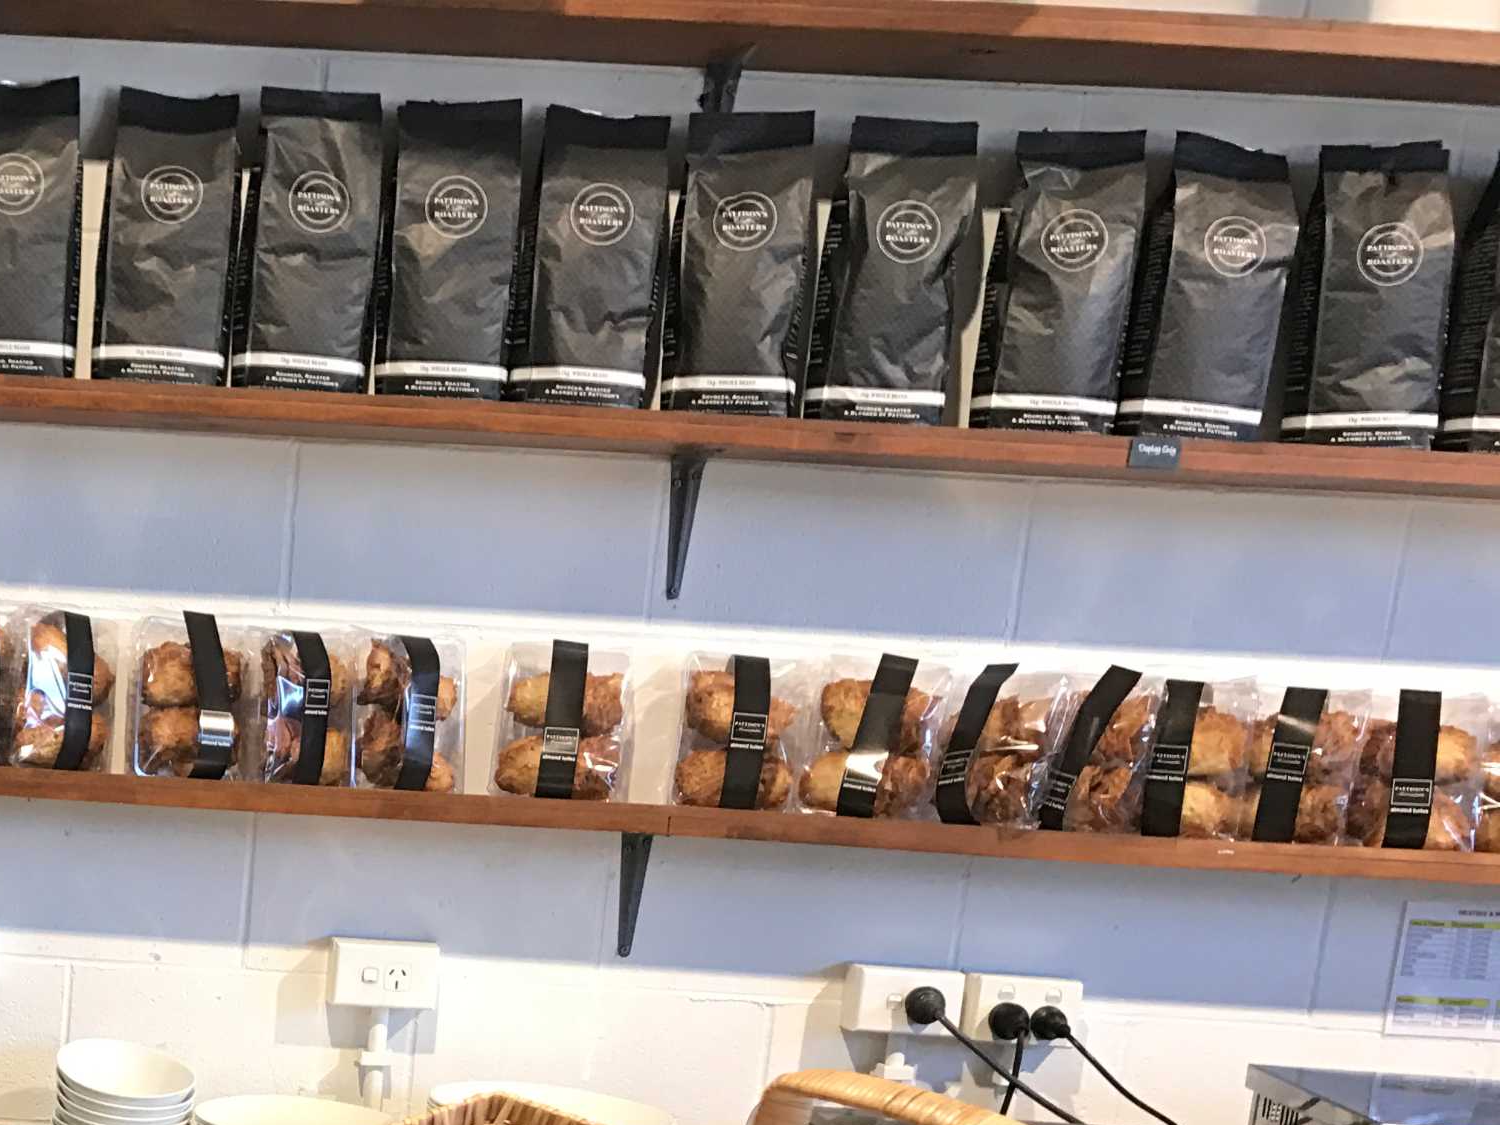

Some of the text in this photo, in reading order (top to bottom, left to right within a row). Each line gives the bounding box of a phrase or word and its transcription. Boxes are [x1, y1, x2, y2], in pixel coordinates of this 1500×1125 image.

[297, 191, 341, 202] PATTISON'S
[434, 197, 479, 206] PATTISON'S
[297, 205, 340, 215] ROASTERS
[579, 204, 625, 214] PATTISON'S
[722, 209, 768, 219] PATTISON'S
[434, 211, 478, 219] ROASTERS
[722, 223, 767, 232] ROASTERS
[886, 220, 932, 230] PATTISON'S
[885, 234, 930, 244] ROASTERS
[1049, 231, 1099, 241] PATTISON'S
[1050, 244, 1098, 253] ROASTERS
[1366, 257, 1413, 266] ROASTERS
